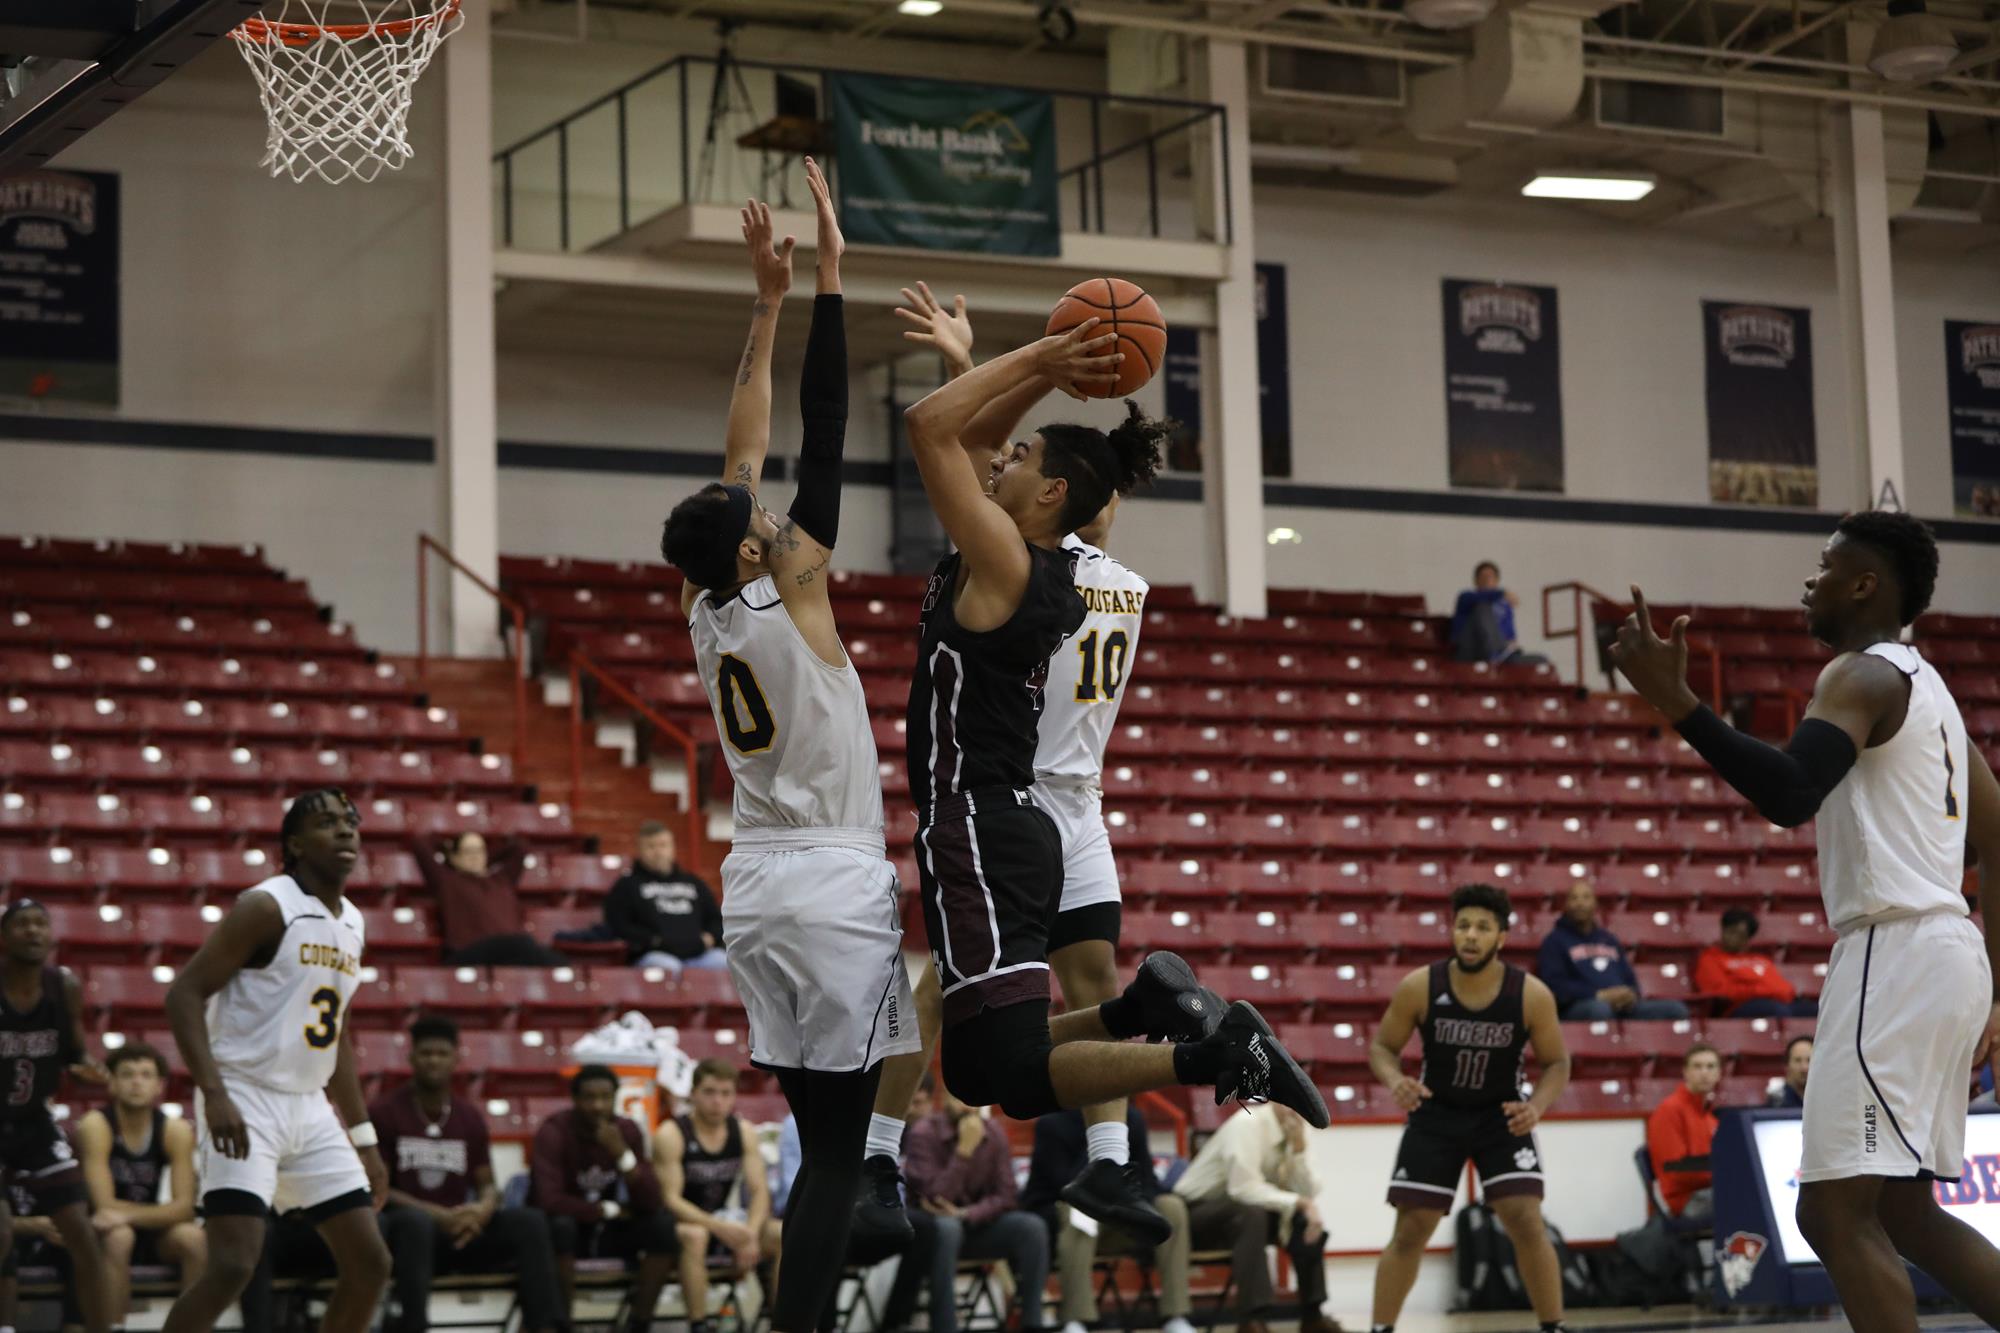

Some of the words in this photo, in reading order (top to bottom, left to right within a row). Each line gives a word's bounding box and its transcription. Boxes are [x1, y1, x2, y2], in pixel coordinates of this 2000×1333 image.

[941, 127, 1004, 155] Bank
[1720, 314, 1794, 359] PATRIOTS
[1075, 628, 1128, 702] 10
[718, 652, 776, 756] 0
[1940, 719, 1961, 821] 1
[305, 985, 341, 1050] 3
[888, 995, 899, 1039] COUGARS
[1433, 1017, 1514, 1048] TIGERS
[1452, 1048, 1491, 1090] 11
[1866, 1103, 1877, 1153] COUGARS
